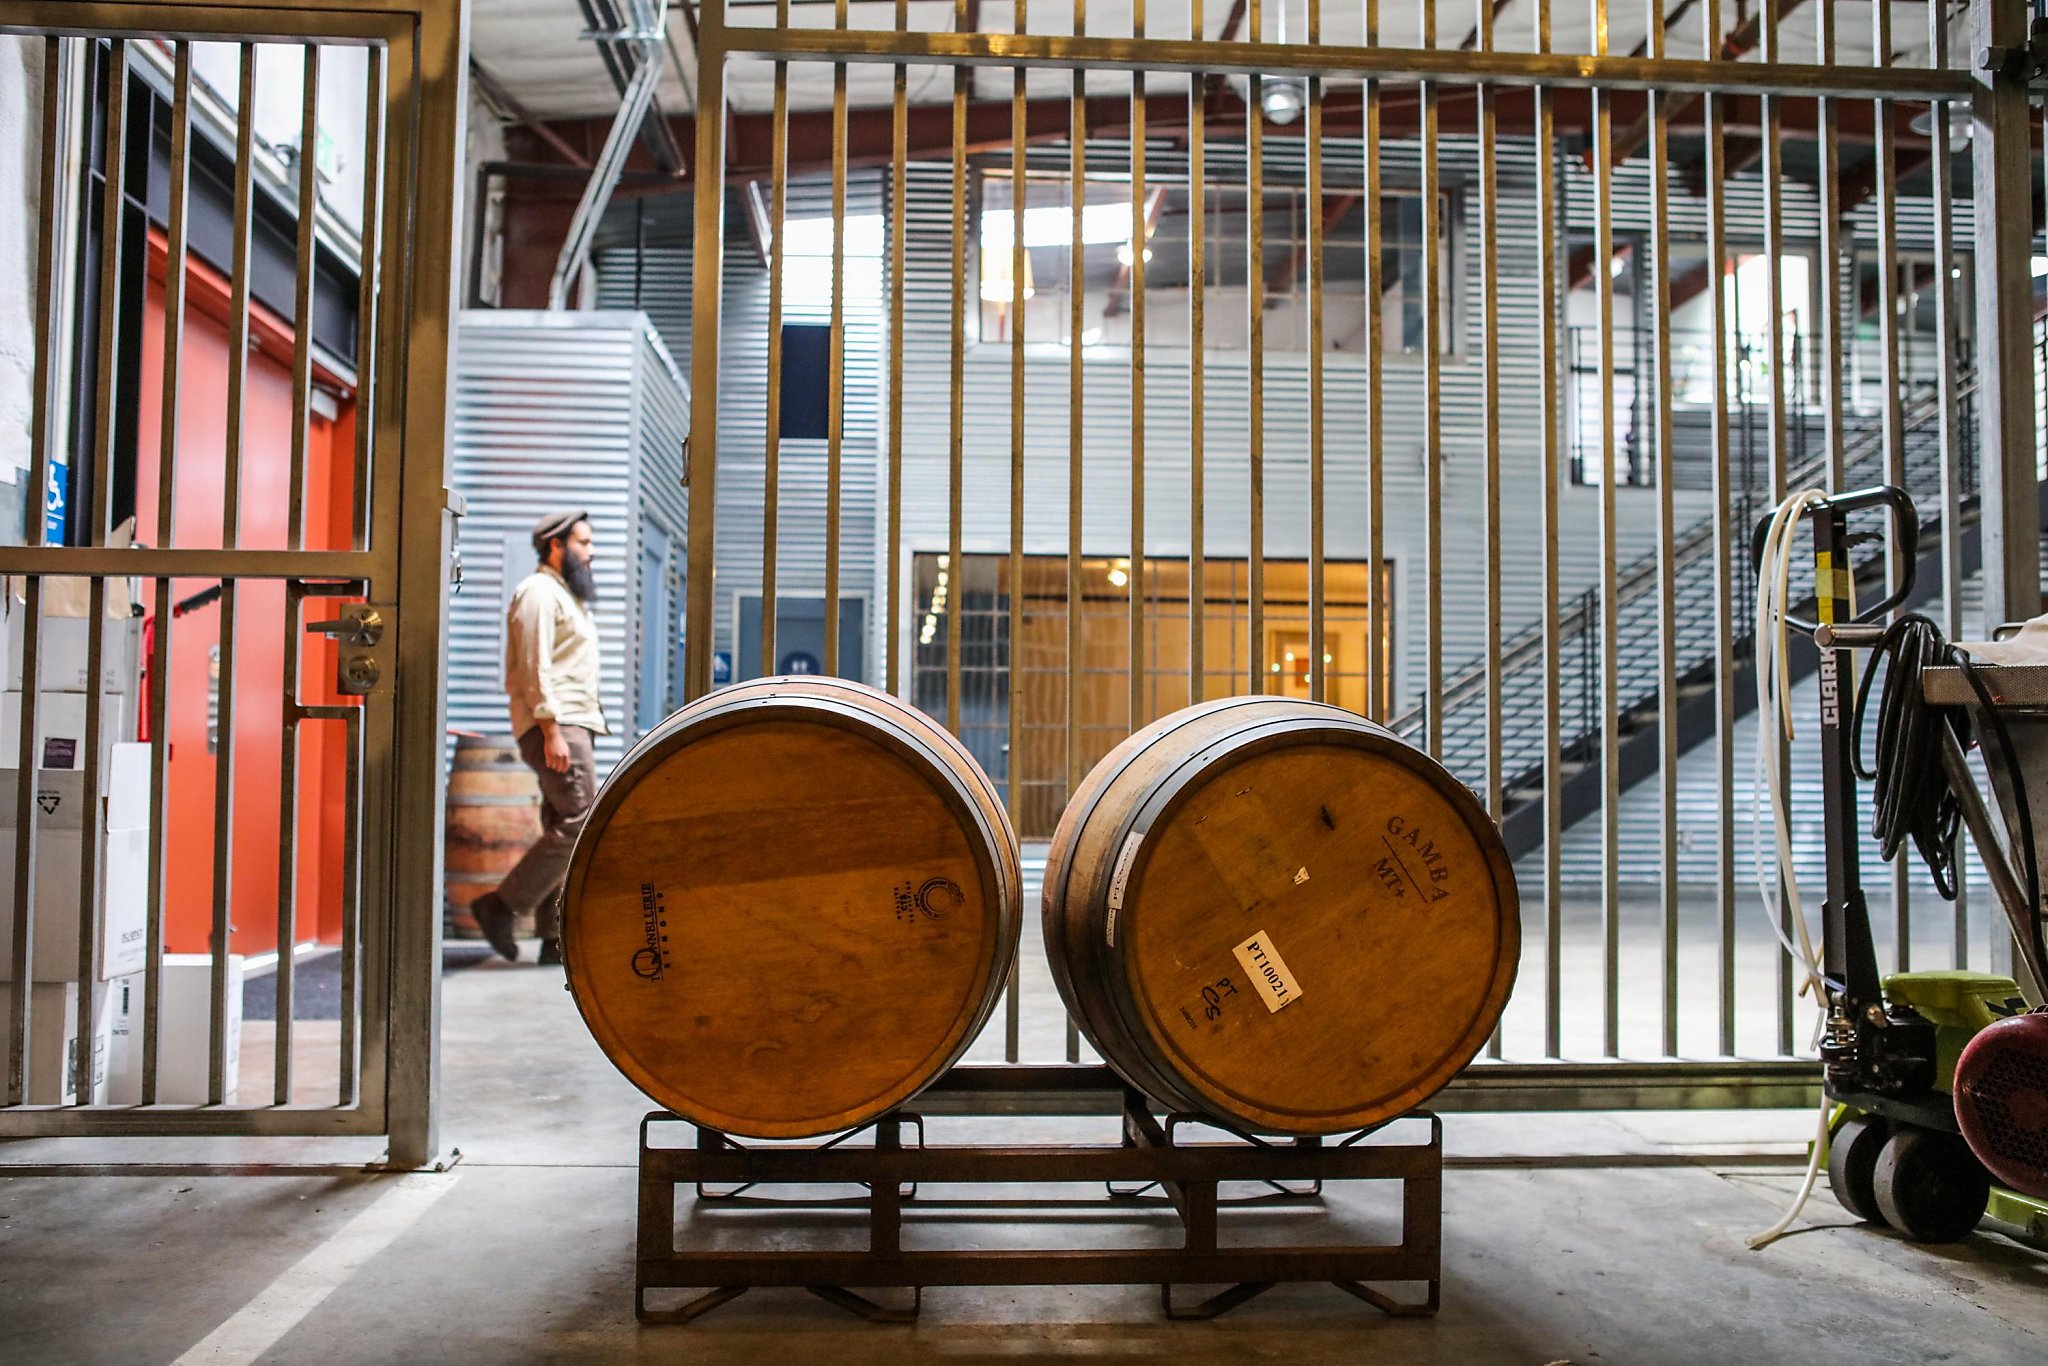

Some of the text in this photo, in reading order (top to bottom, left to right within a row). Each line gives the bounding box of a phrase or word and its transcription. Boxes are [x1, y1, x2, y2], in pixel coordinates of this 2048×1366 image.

[1820, 647, 1839, 724] CLARK
[1373, 857, 1405, 899] MT+
[1386, 816, 1450, 902] GAMBA
[1215, 976, 1239, 998] PT
[1247, 940, 1288, 1000] PT10021
